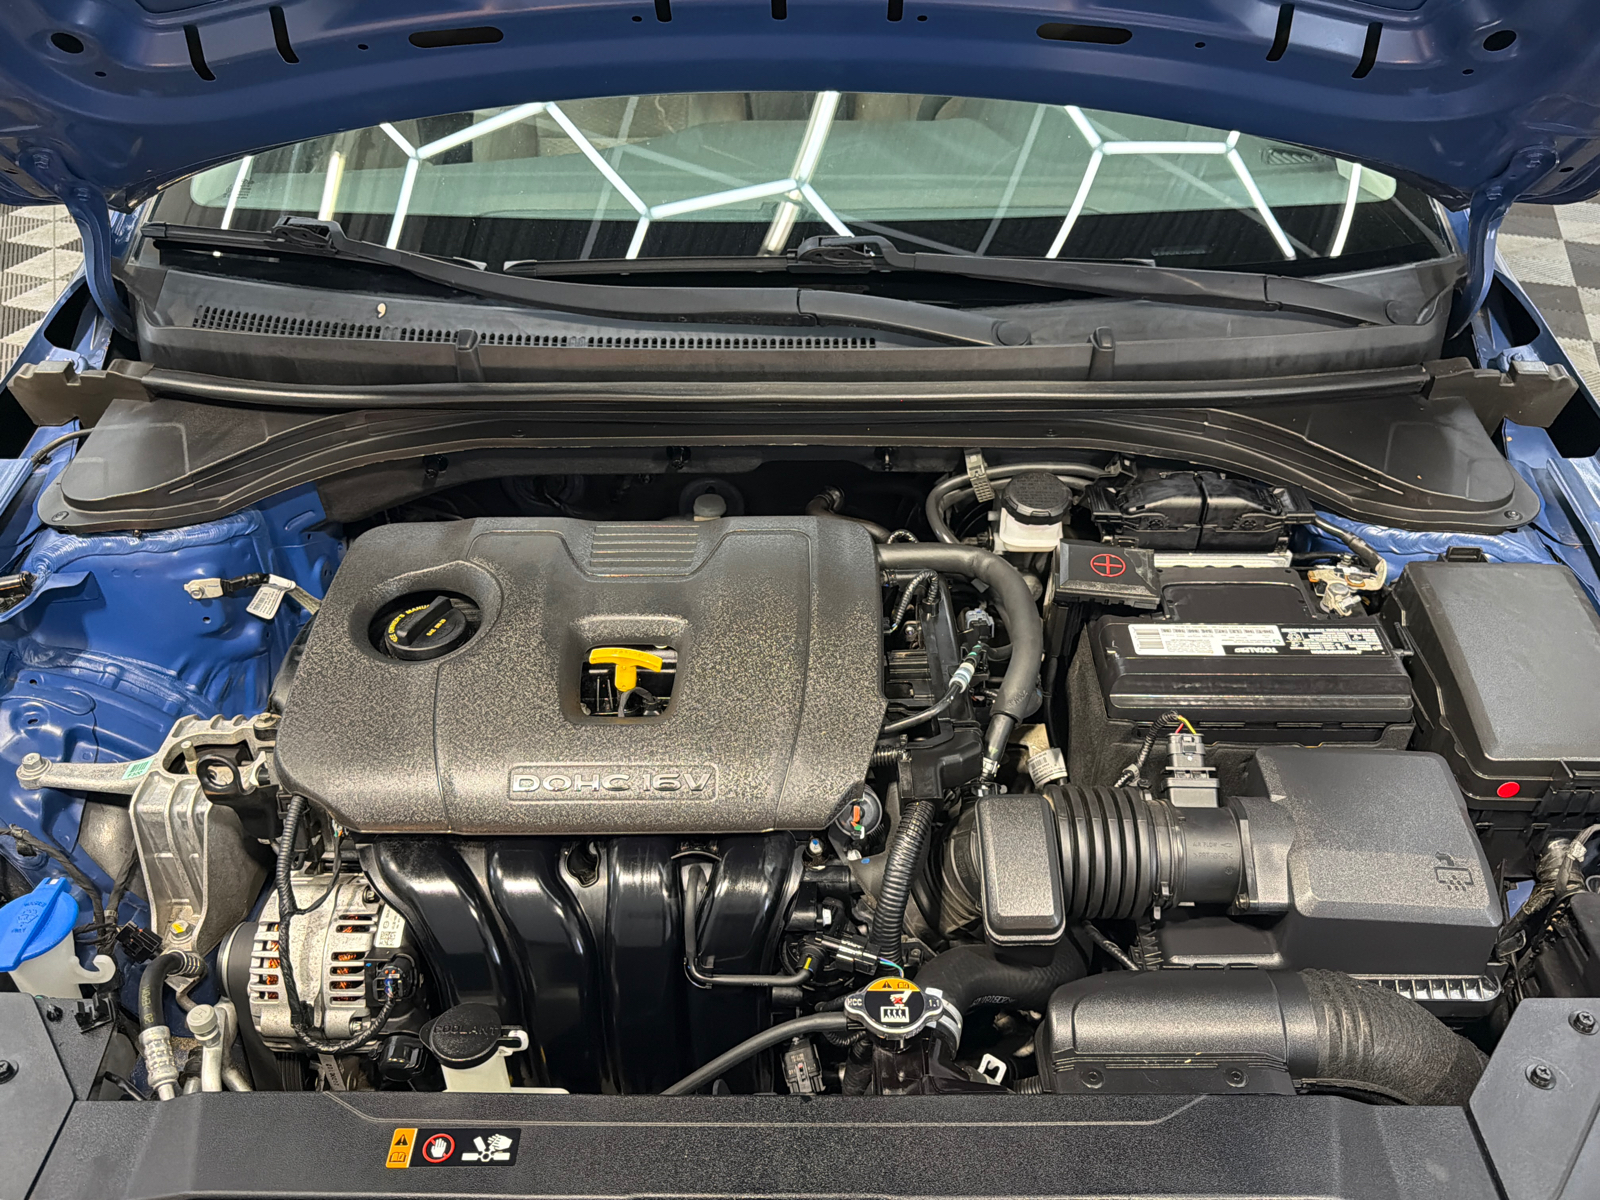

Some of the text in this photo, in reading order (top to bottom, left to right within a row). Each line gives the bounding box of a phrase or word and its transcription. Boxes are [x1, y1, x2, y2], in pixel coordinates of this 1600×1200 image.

[405, 604, 430, 615] MANU
[512, 773, 712, 792] DOHC 16V
[847, 998, 863, 1007] HCC
[928, 999, 940, 1007] 1.1
[433, 1024, 499, 1036] COOLANT
